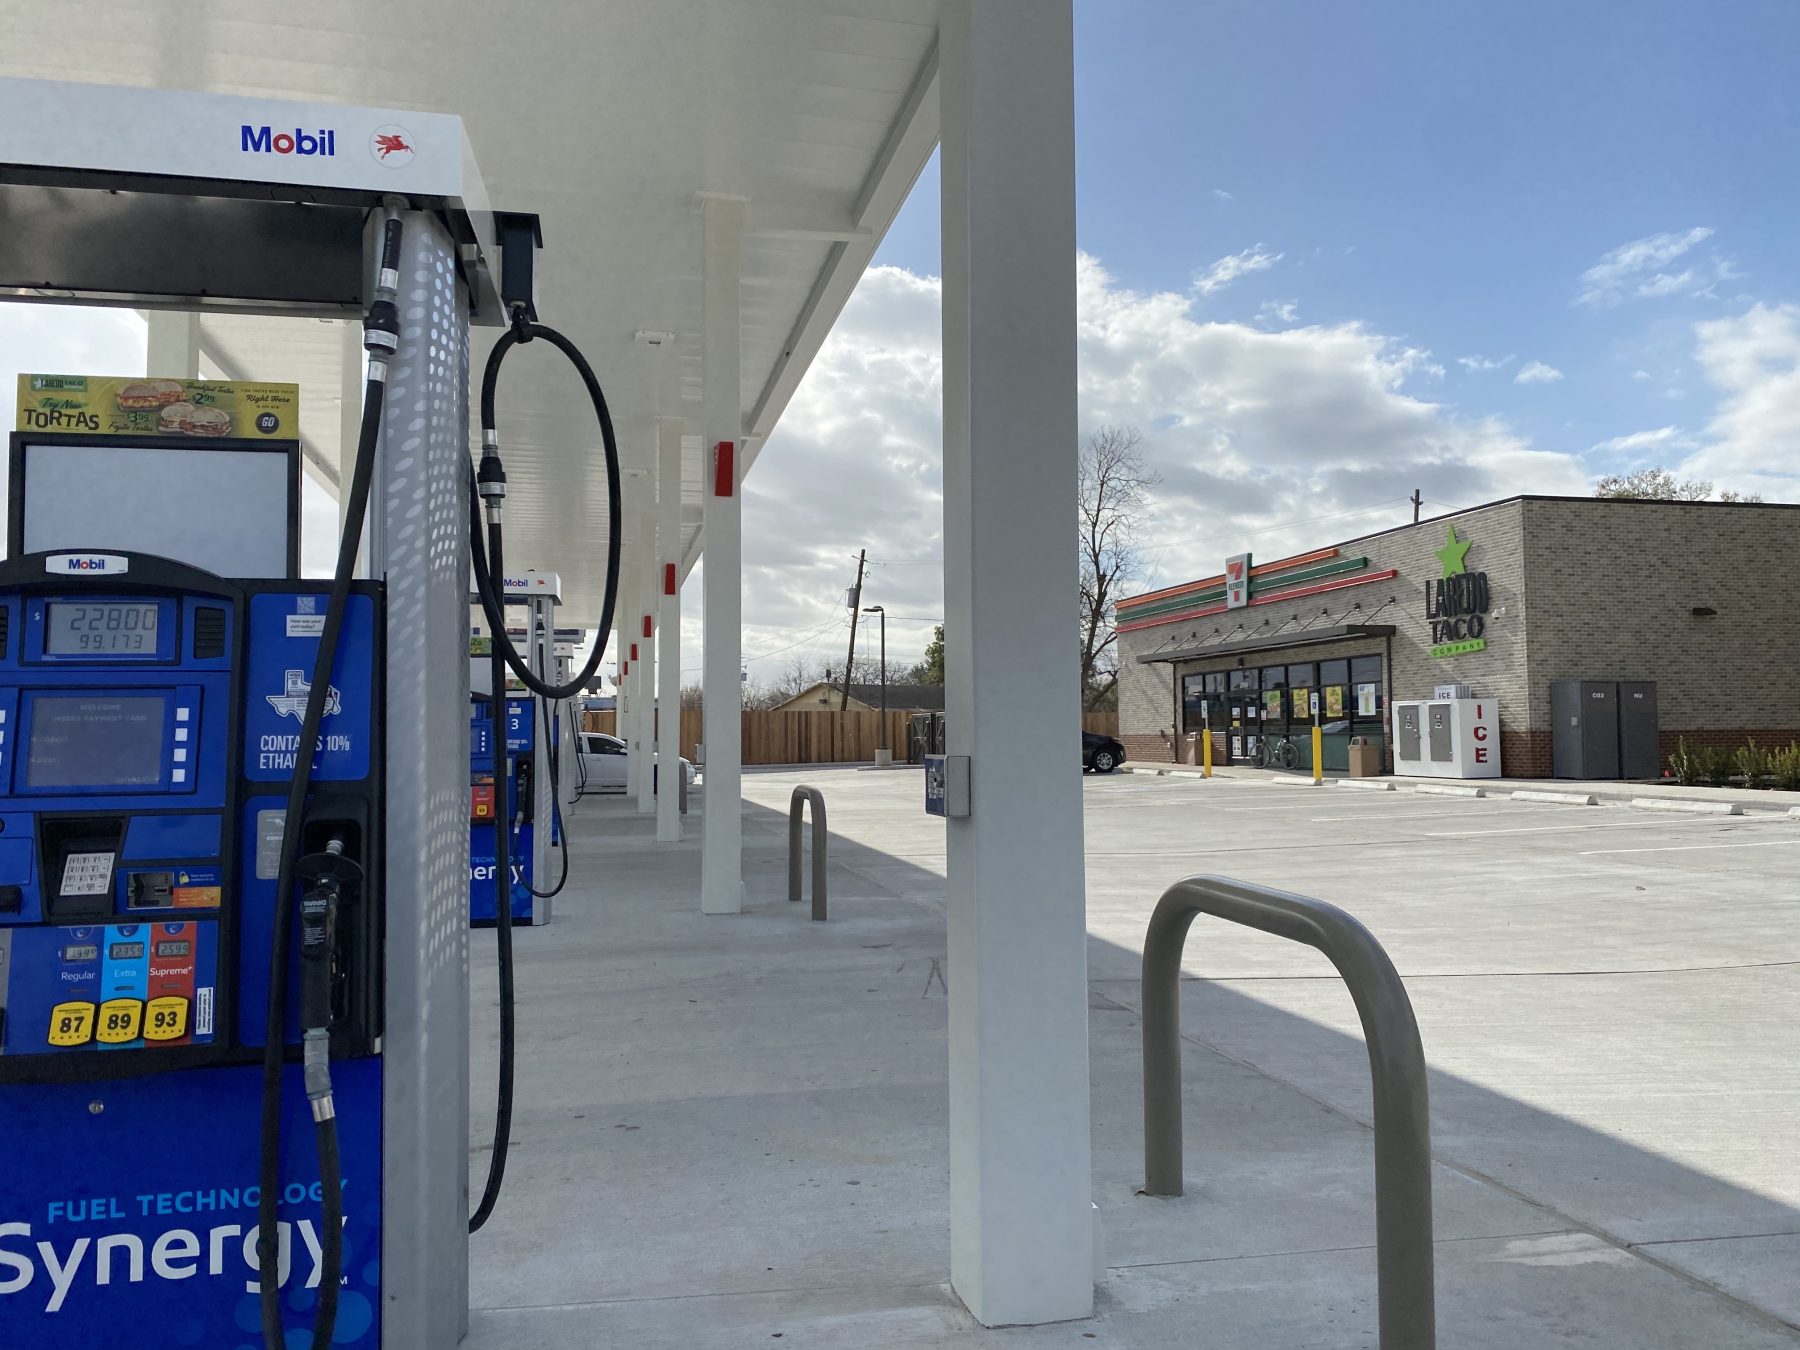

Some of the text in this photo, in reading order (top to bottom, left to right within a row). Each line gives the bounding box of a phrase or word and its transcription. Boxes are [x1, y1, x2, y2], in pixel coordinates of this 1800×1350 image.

[241, 125, 335, 156] Mobil
[23, 408, 100, 431] TORTAS
[262, 416, 275, 427] GO
[69, 559, 105, 570] Mobil
[504, 579, 528, 587] Mobil
[1426, 572, 1488, 619] LAREDO
[1429, 615, 1484, 644] TACO
[80, 634, 142, 649] 99.173
[1432, 642, 1481, 656] COMPANY
[511, 719, 519, 730] 3
[1473, 704, 1487, 763] ICE
[327, 735, 350, 751] 10%
[61, 971, 96, 982] Regular
[60, 1016, 85, 1034] 87
[107, 1013, 132, 1030] 89
[154, 1011, 177, 1028] 93
[48, 1197, 125, 1223] FUEL
